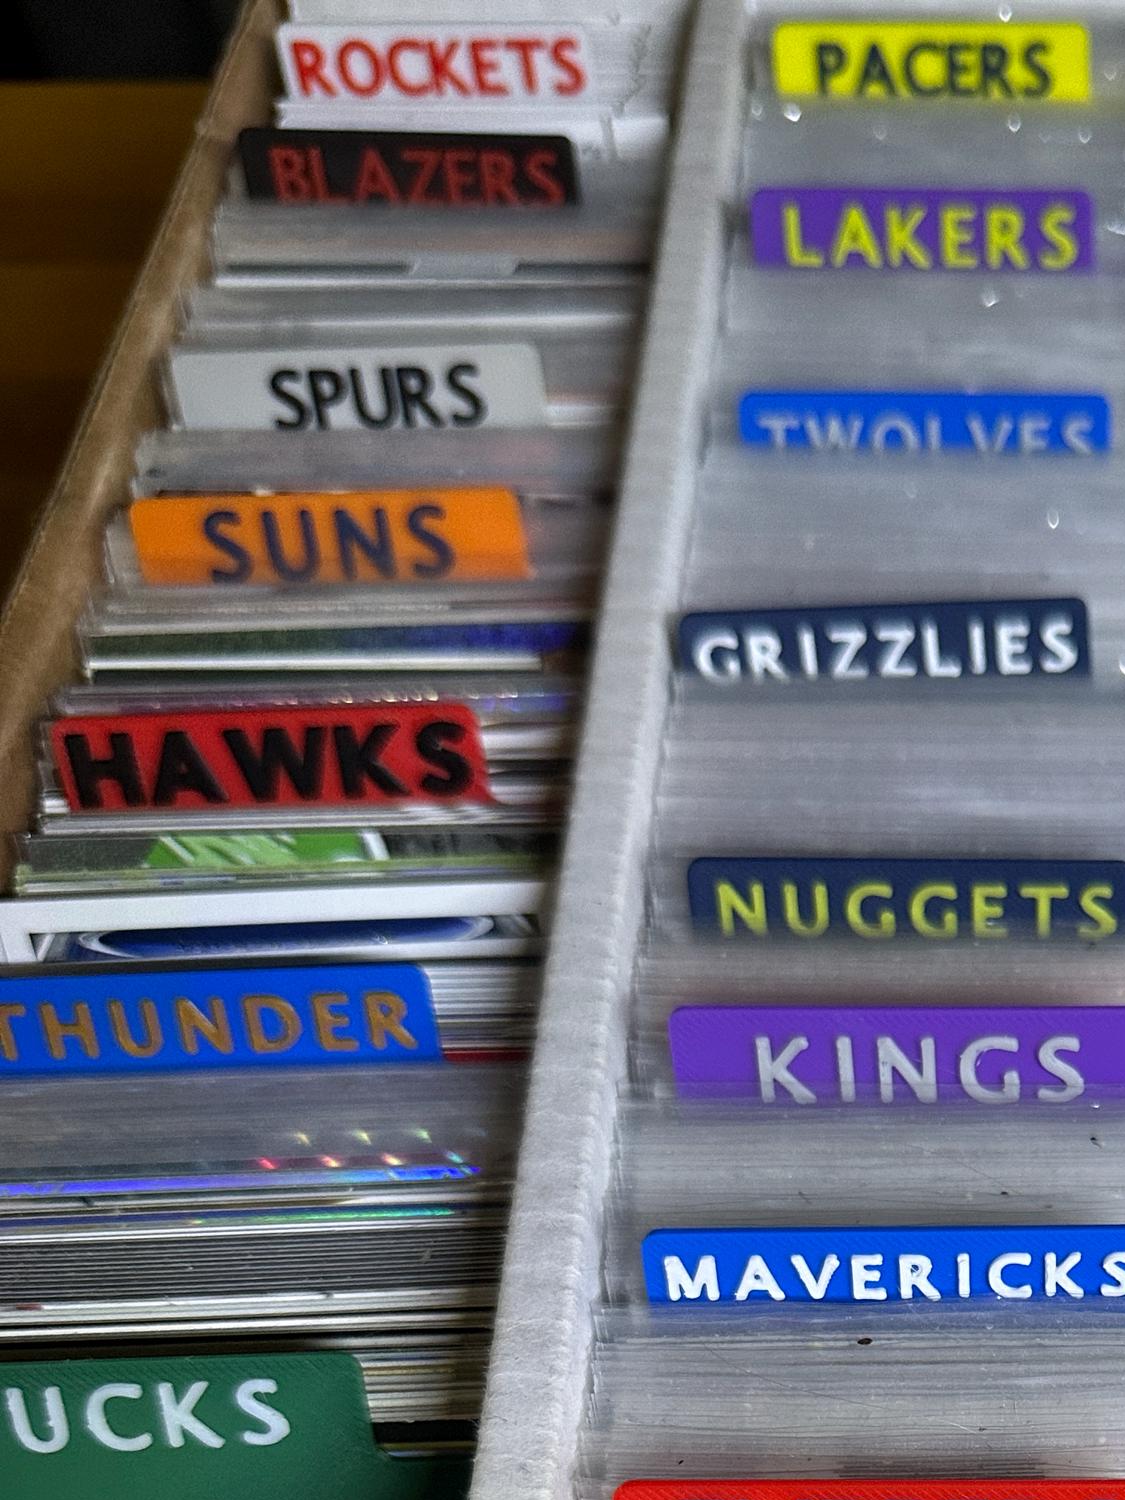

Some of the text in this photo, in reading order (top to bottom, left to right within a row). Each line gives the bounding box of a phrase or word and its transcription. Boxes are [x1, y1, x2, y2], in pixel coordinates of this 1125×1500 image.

[290, 37, 588, 99] ROCKETS
[813, 40, 1057, 99] PACERS
[267, 143, 567, 207] BLAZERS
[781, 202, 1078, 272] LAKERS
[269, 361, 489, 431] SPURS
[202, 504, 456, 585] SUNS
[692, 616, 1082, 684] GRIZZLIES
[64, 719, 475, 810] HAWKS
[716, 880, 1119, 940] NUGGETS
[0, 988, 419, 1062] THUNDER
[753, 1034, 1087, 1105] KINGS
[4, 1377, 292, 1455] UCKS
